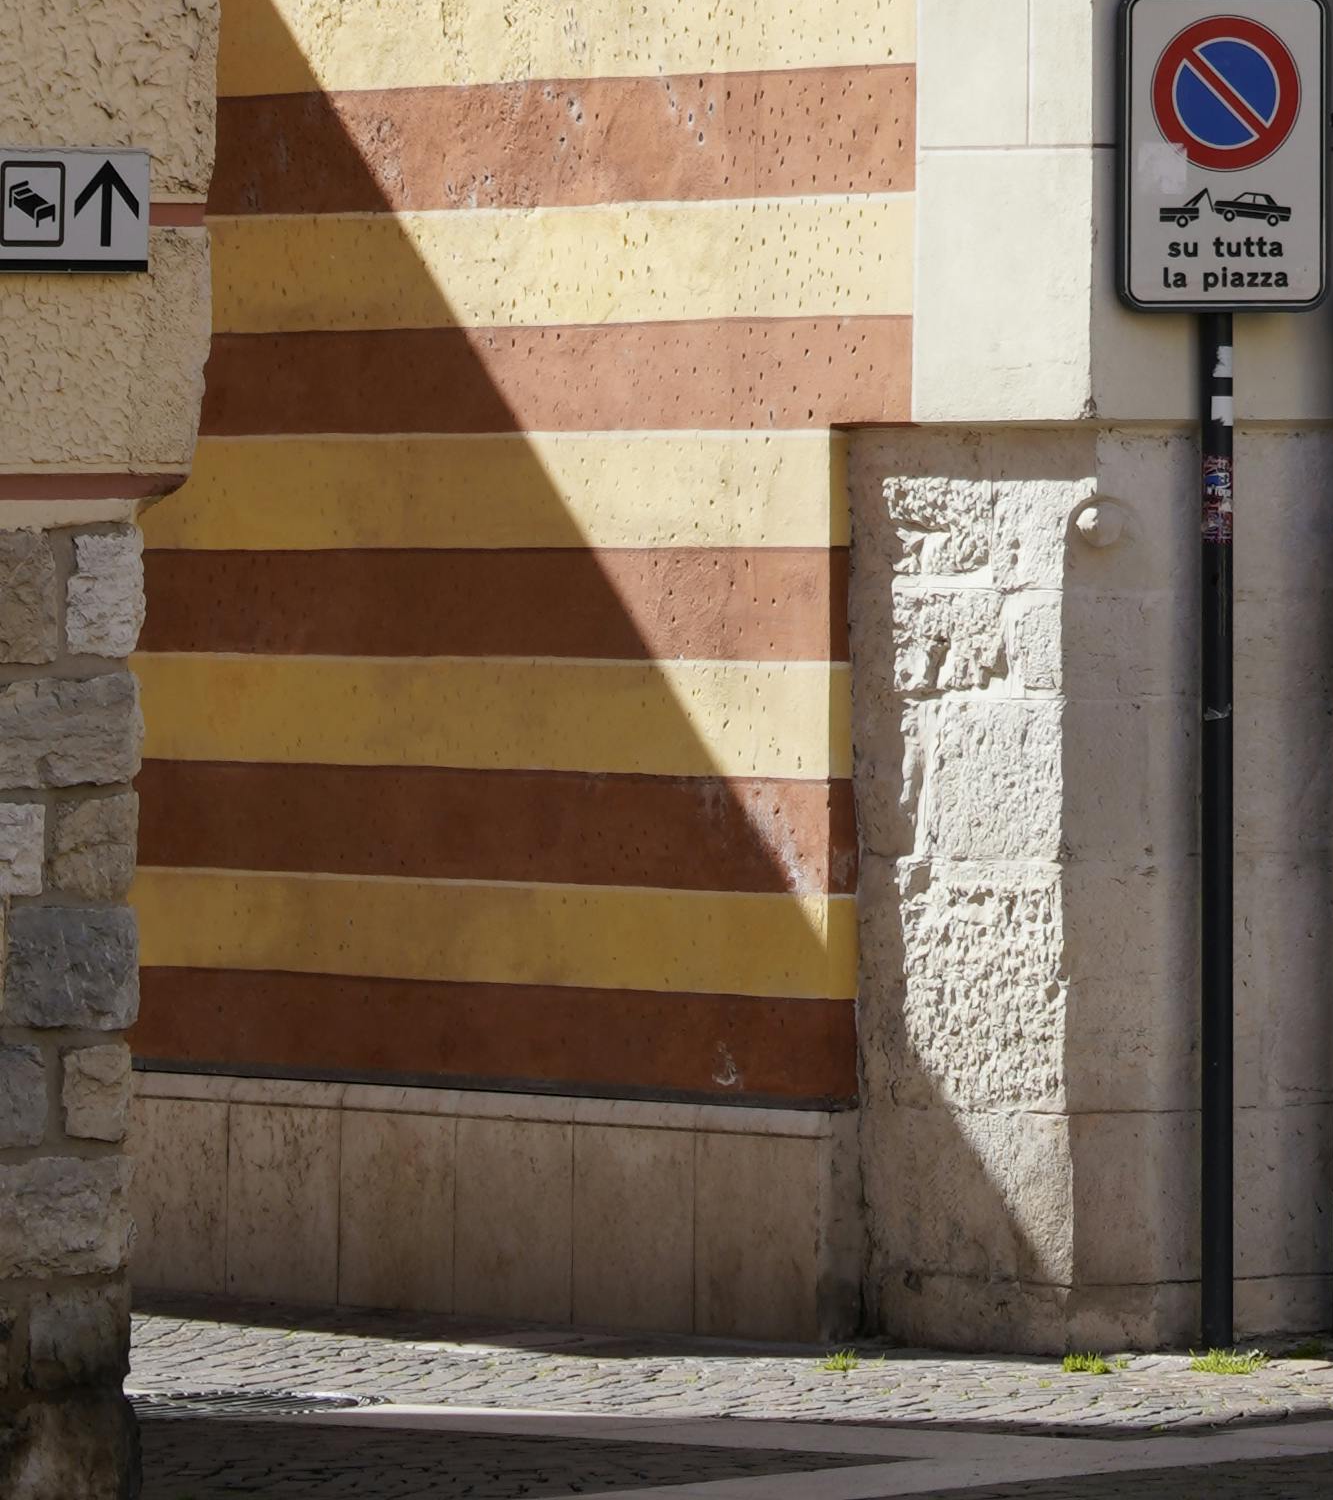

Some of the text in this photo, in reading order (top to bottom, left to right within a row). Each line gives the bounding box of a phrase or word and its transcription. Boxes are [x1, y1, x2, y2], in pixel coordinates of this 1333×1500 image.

[1167, 236, 1283, 258] su tutta
[1163, 266, 1289, 292] la piazza
